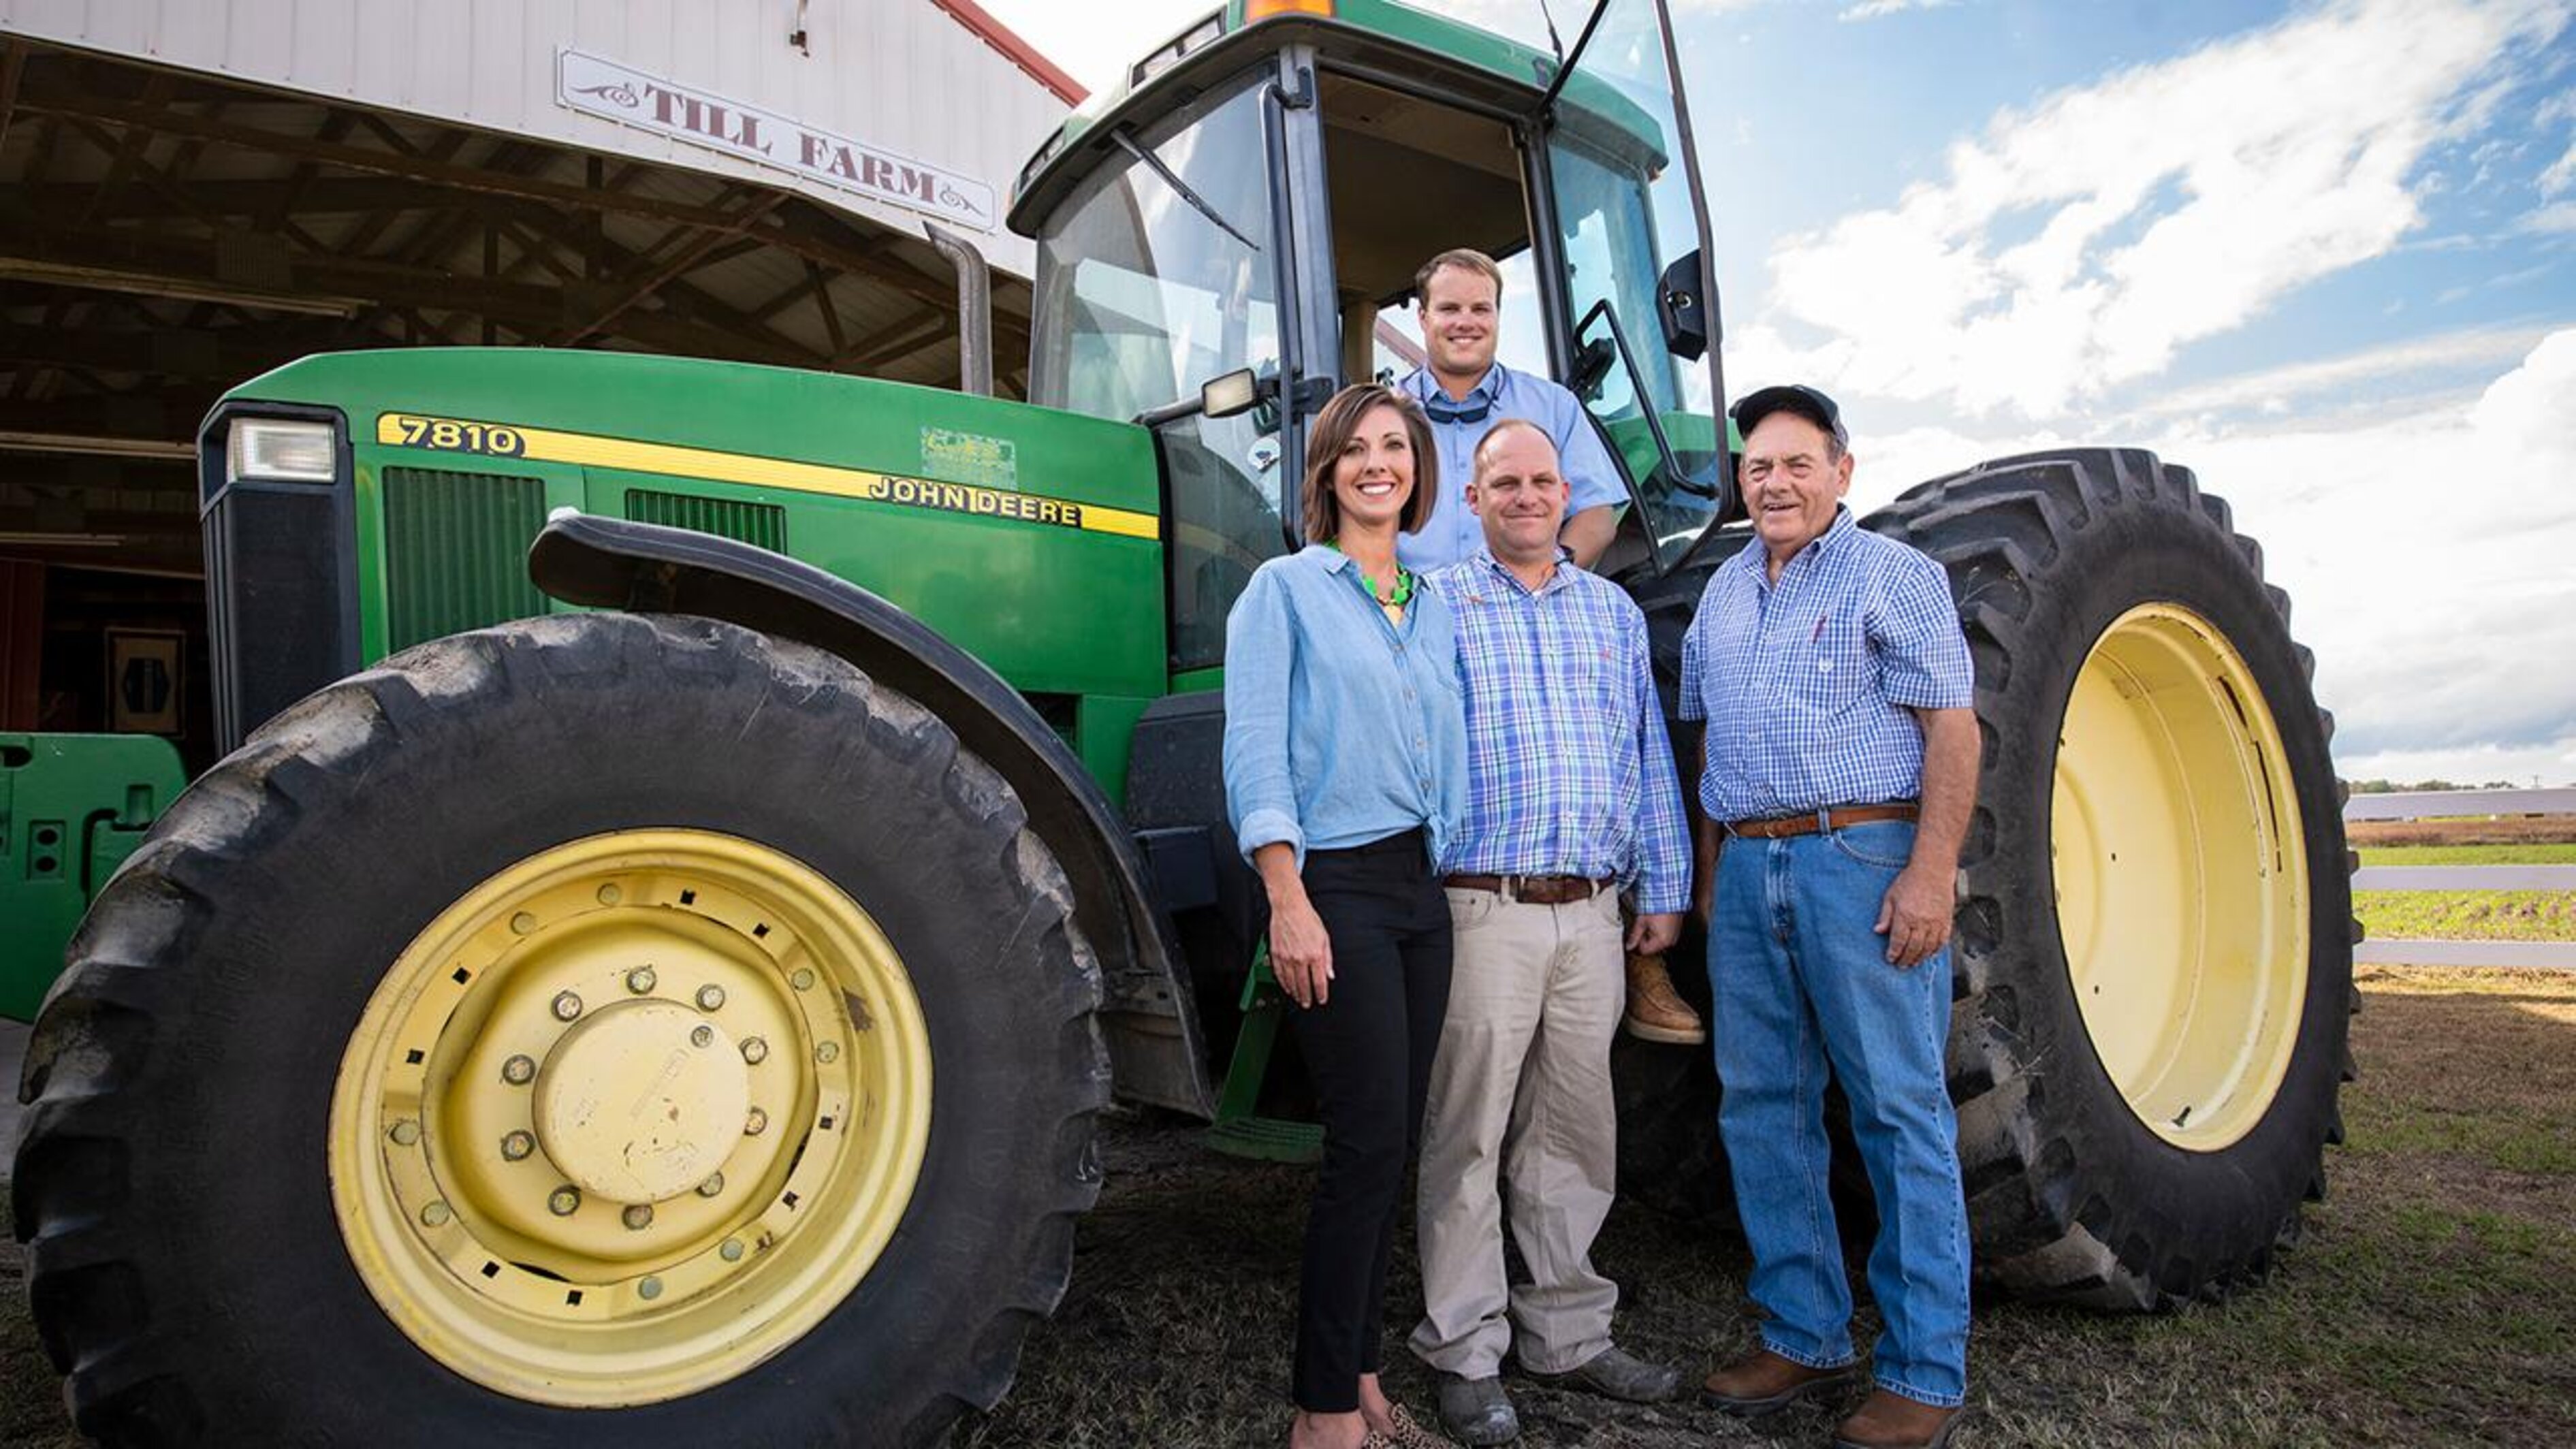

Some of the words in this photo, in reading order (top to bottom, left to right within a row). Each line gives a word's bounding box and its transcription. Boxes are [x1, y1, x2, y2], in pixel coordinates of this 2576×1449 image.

[644, 82, 773, 157] TILL
[797, 130, 937, 204] FARM
[398, 417, 521, 455] 7810
[870, 477, 966, 512] JOHN
[976, 490, 1081, 526] DEERE
